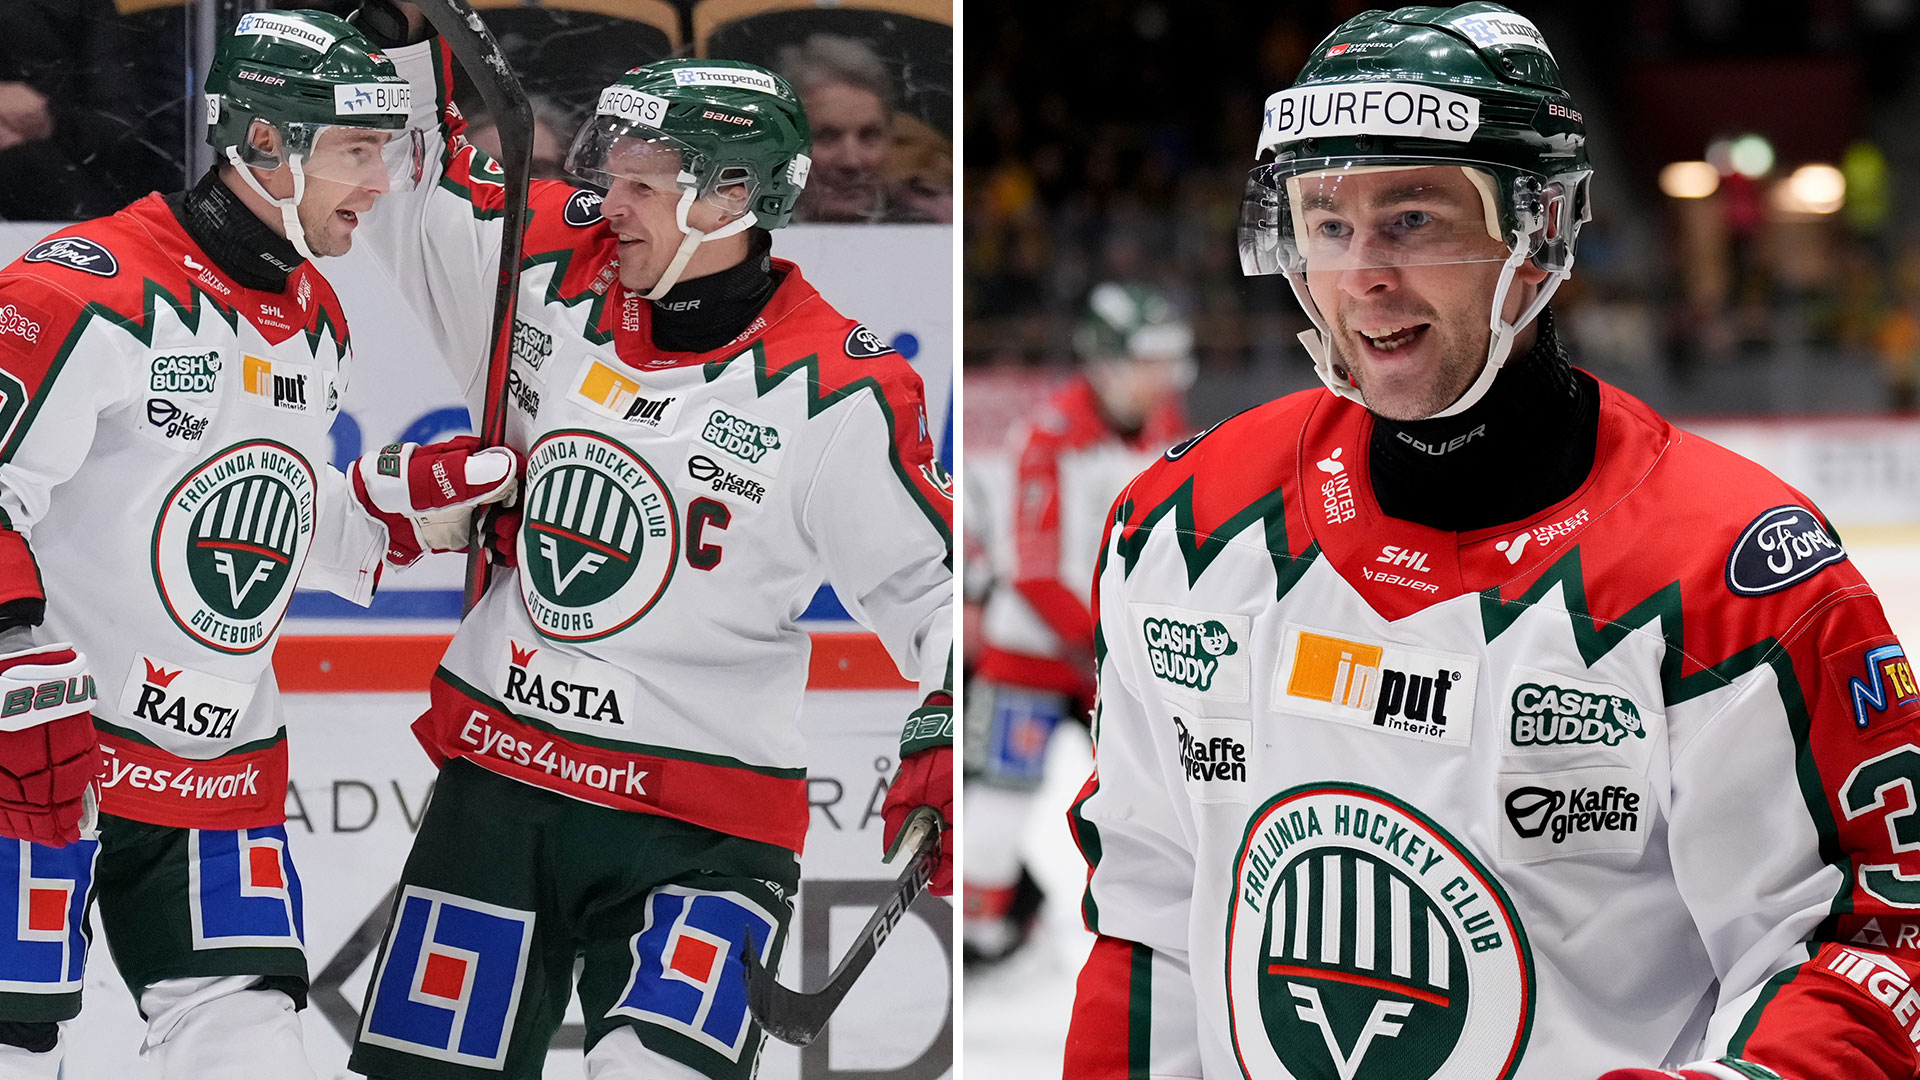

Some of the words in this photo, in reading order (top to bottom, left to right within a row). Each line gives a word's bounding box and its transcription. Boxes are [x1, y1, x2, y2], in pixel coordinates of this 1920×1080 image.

[254, 17, 326, 47] Tranpenad
[696, 71, 771, 89] Tranpenad
[1278, 91, 1469, 135] BJURFORS
[35, 240, 102, 266] Ford
[202, 268, 232, 295] INTER
[259, 304, 285, 319] SHL
[621, 299, 632, 332] SPORT
[630, 299, 640, 332] INTER
[151, 374, 216, 392] BUDDY
[153, 358, 203, 375] CASH
[710, 411, 760, 442] CASH
[702, 424, 766, 463] BUDDY
[178, 453, 255, 512] FRÖLUNDA
[261, 451, 307, 490] HOCKEY
[299, 491, 312, 535] CLUB
[584, 443, 646, 490] HOCKEY
[640, 492, 667, 538] CLUB
[711, 478, 762, 504] greven
[725, 471, 765, 497] Kaffe
[1334, 473, 1357, 522] INTER
[1321, 479, 1342, 525] SPORT
[686, 496, 732, 572] C
[1532, 508, 1590, 536] INTER
[1536, 513, 1592, 547] SPORT
[1376, 545, 1431, 573] SHL
[1757, 515, 1837, 575] Ford
[1373, 571, 1440, 594] BAUER
[191, 608, 263, 644] GÖTEBORG
[528, 594, 594, 632] GÖTEBORG
[1145, 621, 1197, 656] CASH
[1149, 649, 1215, 688] BUDDY
[132, 682, 241, 740] RASTA
[503, 664, 625, 725] RASTA
[1516, 687, 1608, 719] CASH
[1515, 715, 1625, 744] BUDDY
[459, 709, 650, 797] Eyes4work
[1187, 733, 1246, 763] Kaffe
[1568, 785, 1640, 814] Kaffe
[1551, 811, 1638, 844] greven
[1244, 805, 1324, 914] FRÖLUNDA
[1334, 804, 1445, 877] HOCKEY
[1440, 875, 1504, 954] CLUB
